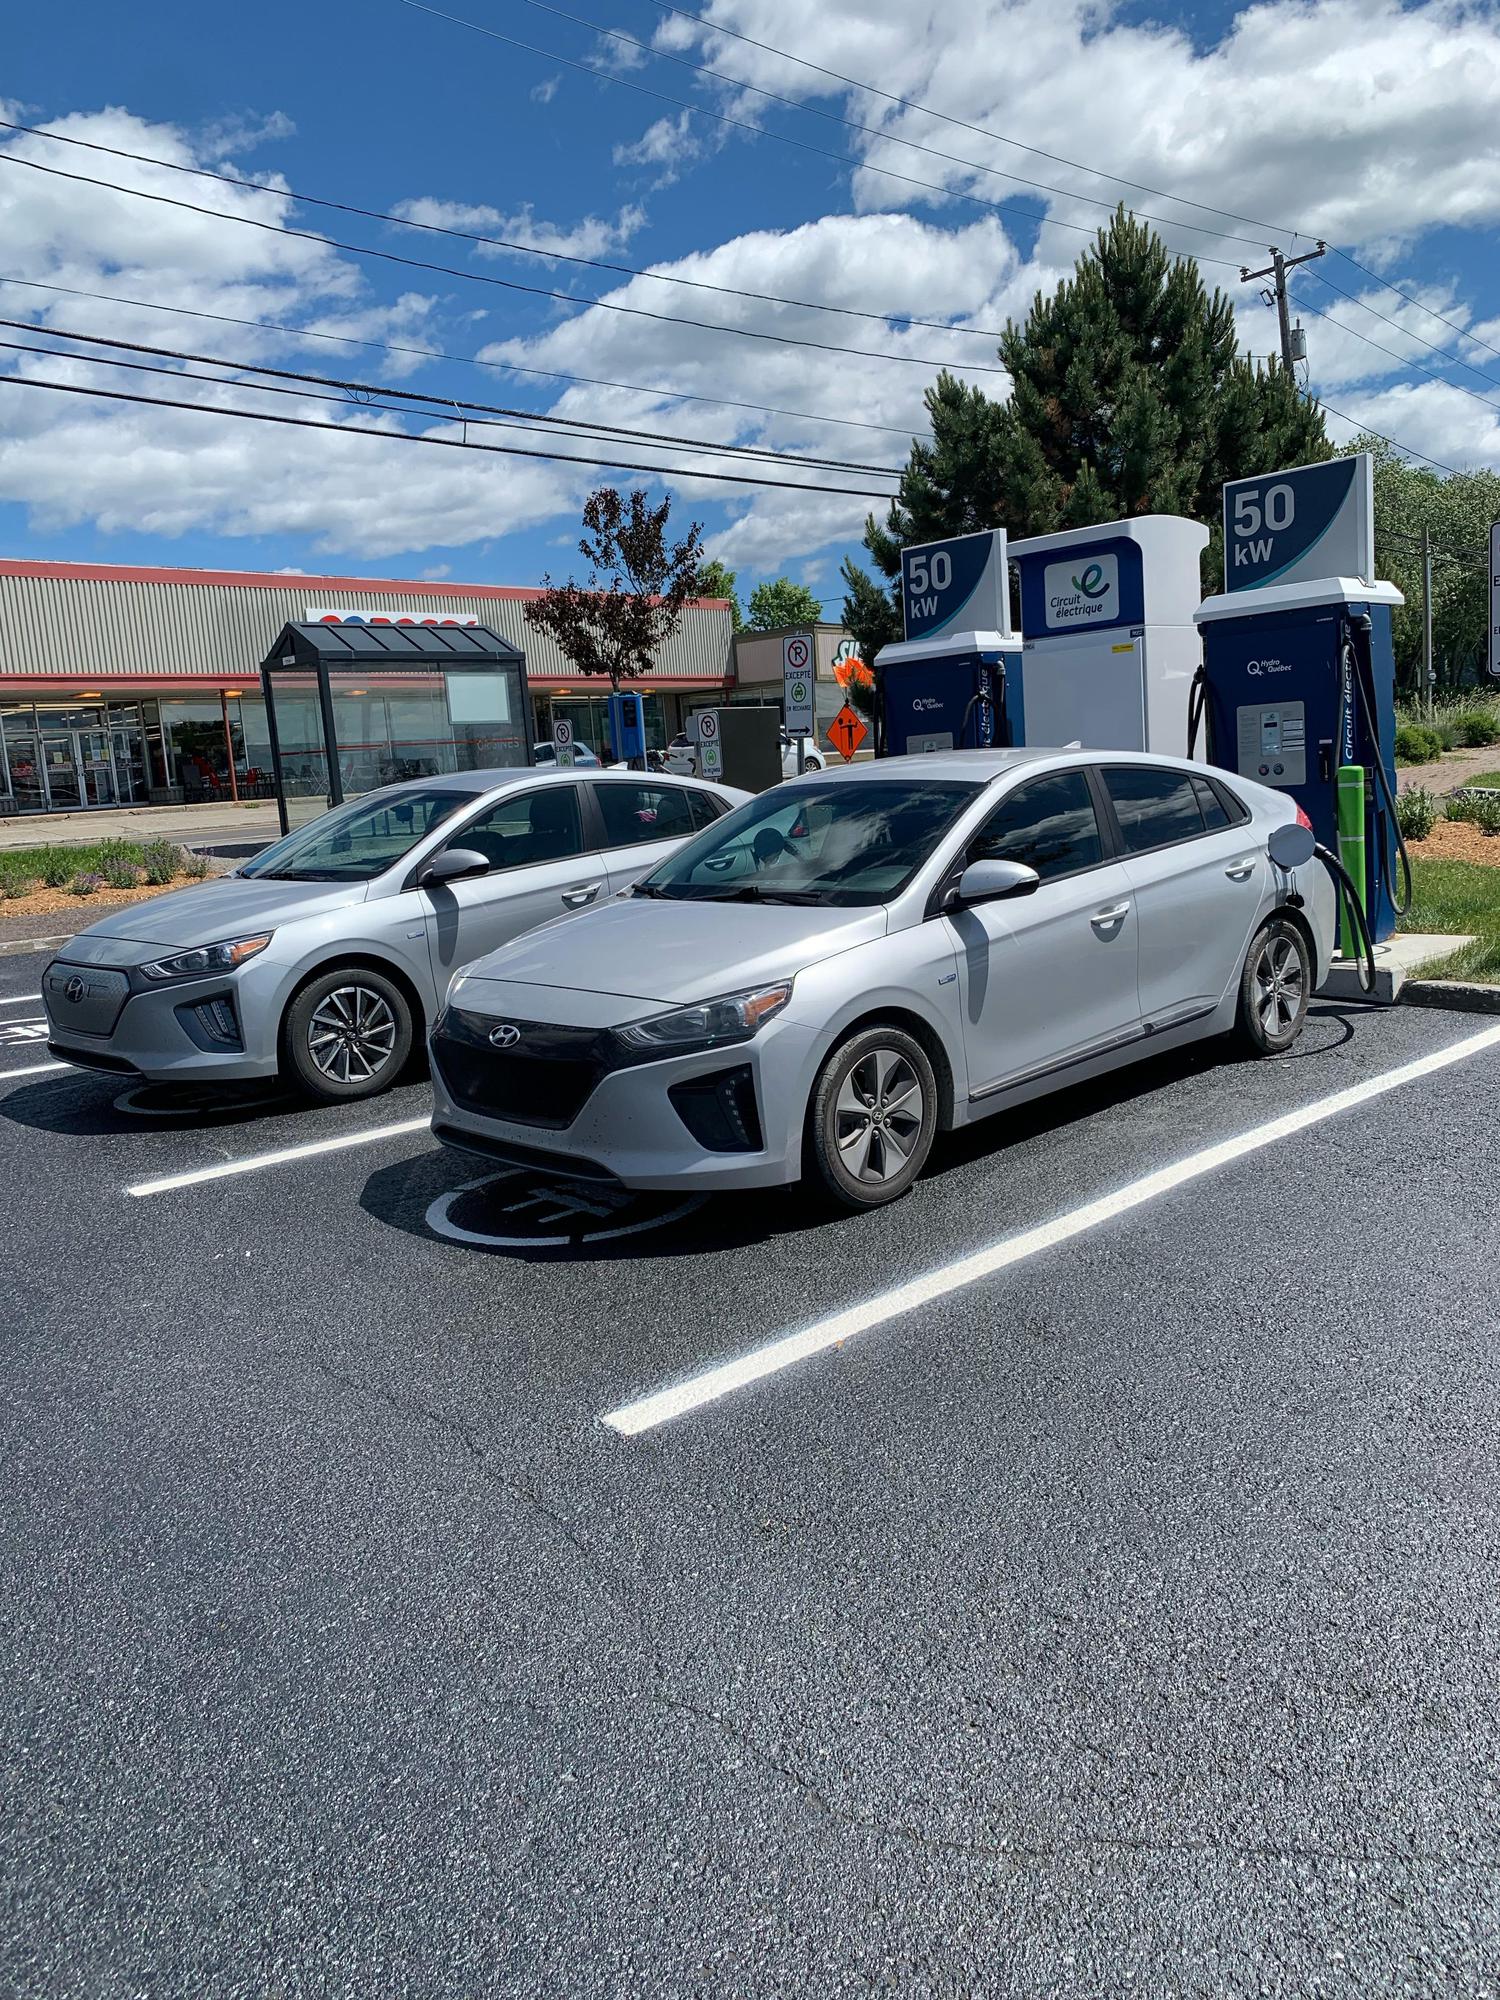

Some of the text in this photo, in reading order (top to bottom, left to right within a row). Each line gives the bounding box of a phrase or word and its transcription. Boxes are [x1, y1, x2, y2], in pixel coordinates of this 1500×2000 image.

[1233, 484, 1295, 537] 50
[1233, 538, 1274, 567] kW
[909, 551, 952, 595] 50
[910, 596, 938, 619] kW
[1050, 594, 1081, 608] Circuit
[1056, 603, 1103, 619] électrique
[1261, 659, 1280, 667] Hydro
[1267, 664, 1292, 673] Québec
[980, 669, 991, 735] électque
[1343, 624, 1353, 760] Circuit électre
